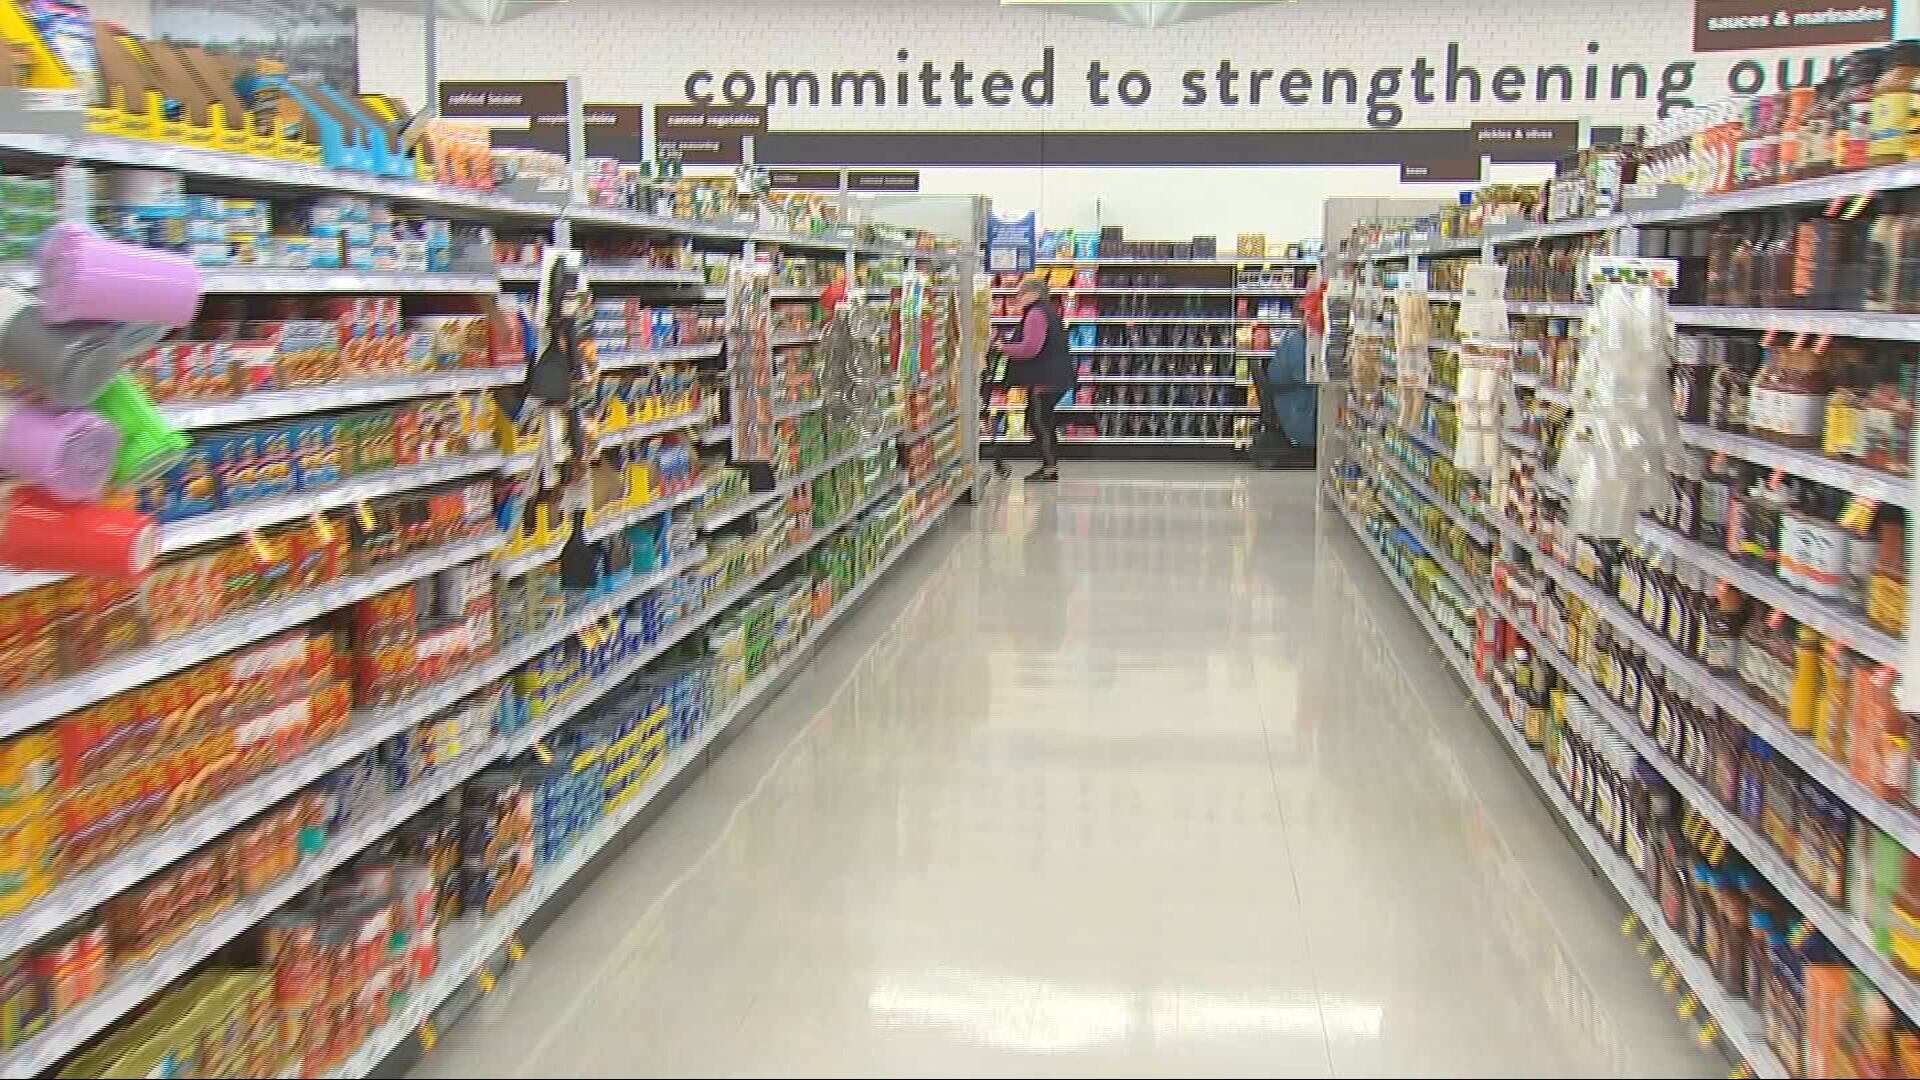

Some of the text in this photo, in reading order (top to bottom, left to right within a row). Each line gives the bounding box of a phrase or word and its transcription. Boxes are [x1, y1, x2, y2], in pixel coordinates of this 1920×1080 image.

[1707, 6, 1888, 31] sauces & marinades
[684, 46, 1055, 106] committed
[1086, 59, 1152, 106] to
[1181, 41, 1696, 129] strengthening
[448, 93, 523, 105] refried beans
[667, 113, 761, 128] canned vegetables
[1477, 128, 1554, 141] pickles & olives
